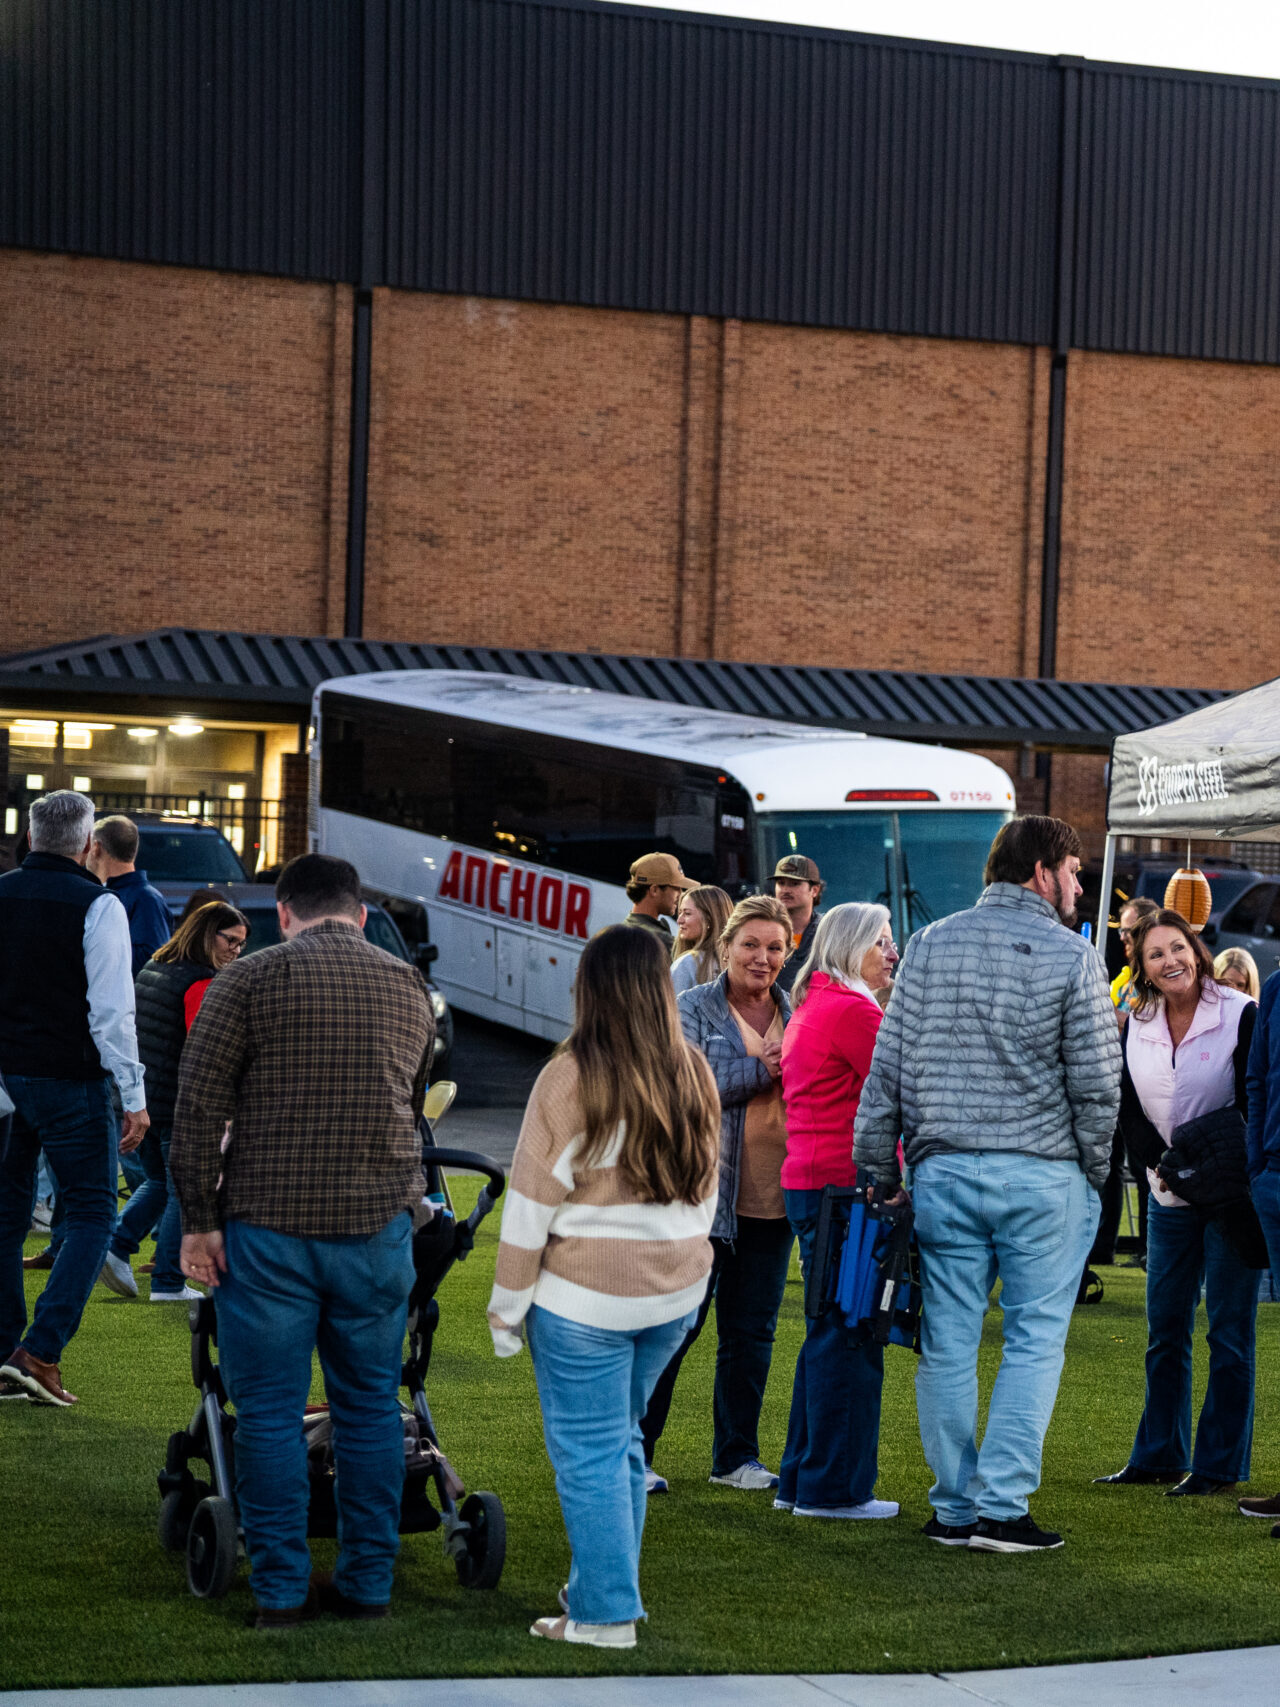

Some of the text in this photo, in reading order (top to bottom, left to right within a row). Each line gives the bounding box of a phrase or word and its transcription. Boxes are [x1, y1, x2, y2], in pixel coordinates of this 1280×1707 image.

[1158, 760, 1229, 805] COOPER STEEL
[438, 850, 591, 939] ANCHOR
